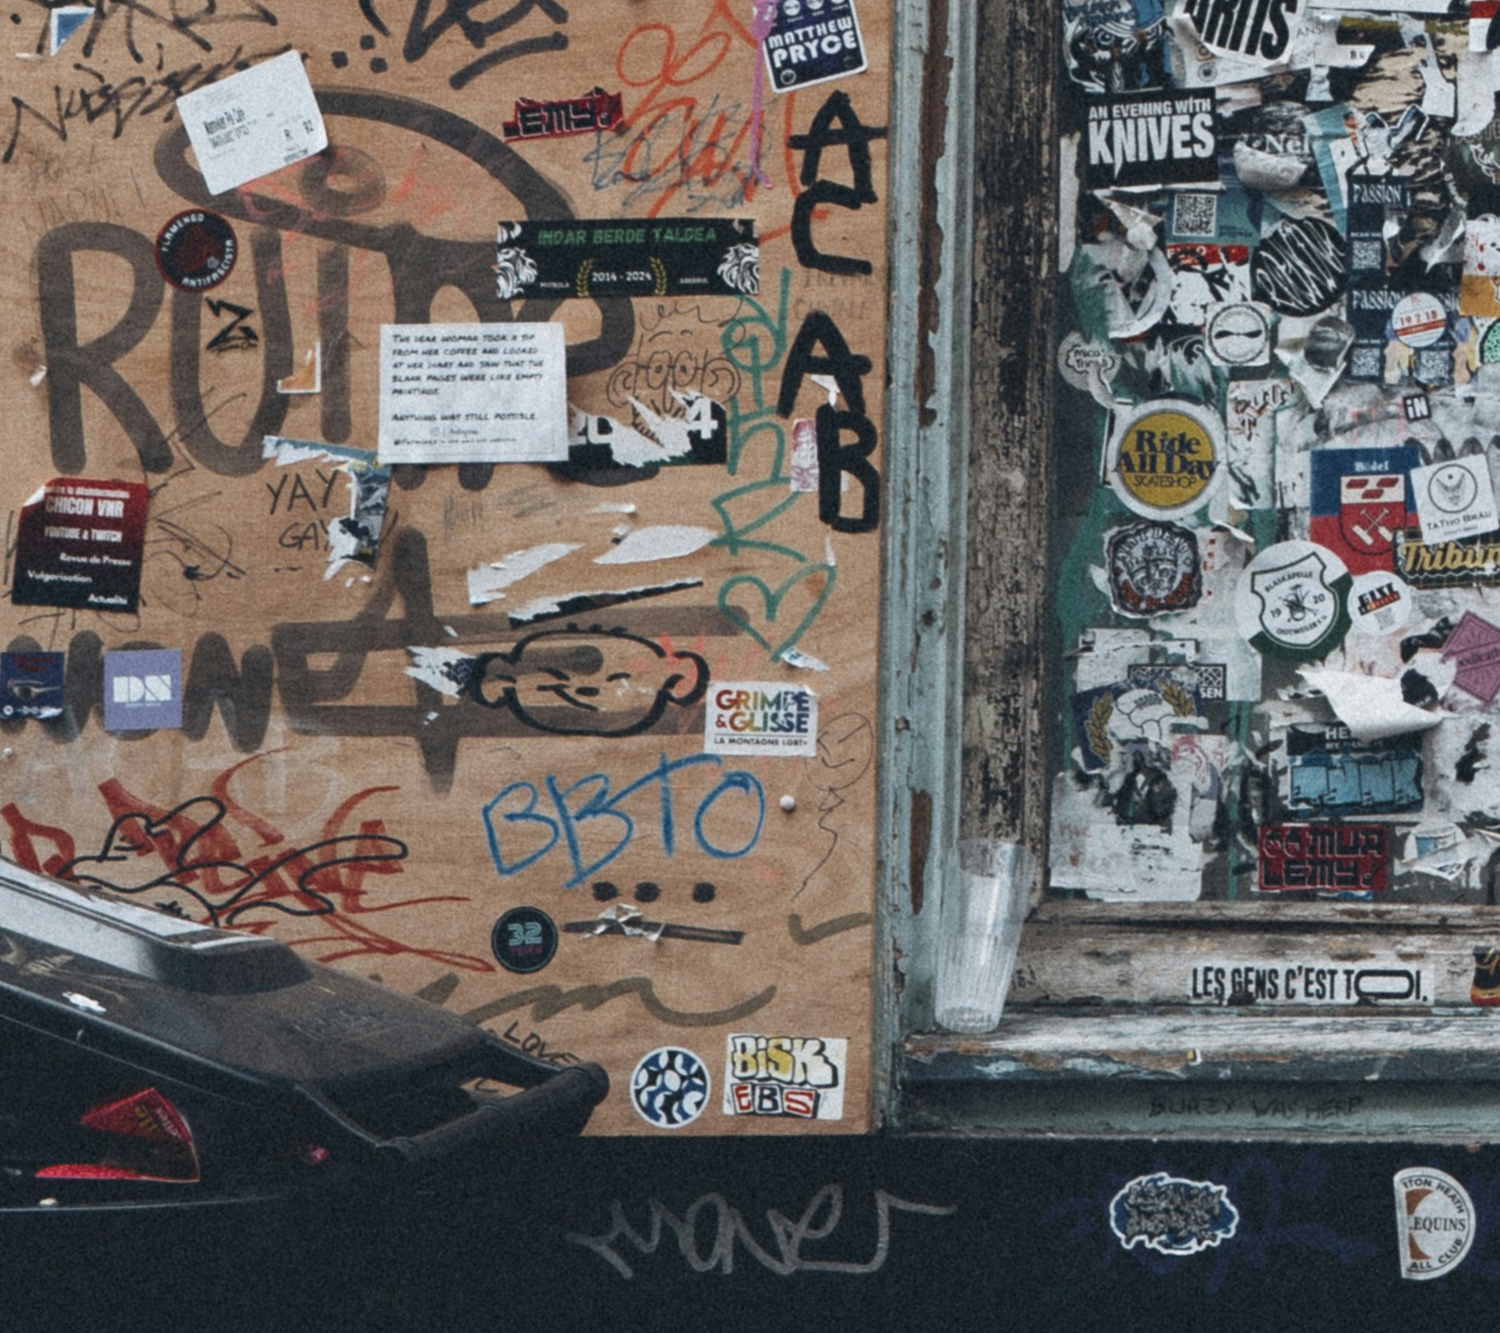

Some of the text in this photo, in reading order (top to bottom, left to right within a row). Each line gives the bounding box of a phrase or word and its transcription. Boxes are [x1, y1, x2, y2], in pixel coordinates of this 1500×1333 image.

[768, 16, 853, 49] MATTHEW
[773, 31, 857, 68] PRYCE
[1088, 113, 1214, 178] KNIVES
[593, 229, 646, 244] BERDE
[651, 228, 716, 243] TALDEA
[592, 271, 651, 282] 2014 2024
[1135, 429, 1201, 457] Ride
[1134, 474, 1198, 490] SKATESHOP
[45, 496, 124, 517] CHICON VNR
[60, 552, 131, 565] Revue de Presse
[28, 570, 92, 582] Vulgarisation
[716, 689, 809, 711] GRIMPE
[729, 712, 809, 733] GLISSE
[1192, 966, 1228, 1000] LES
[1231, 966, 1280, 1004] GENS
[1284, 963, 1339, 1002] C'EST
